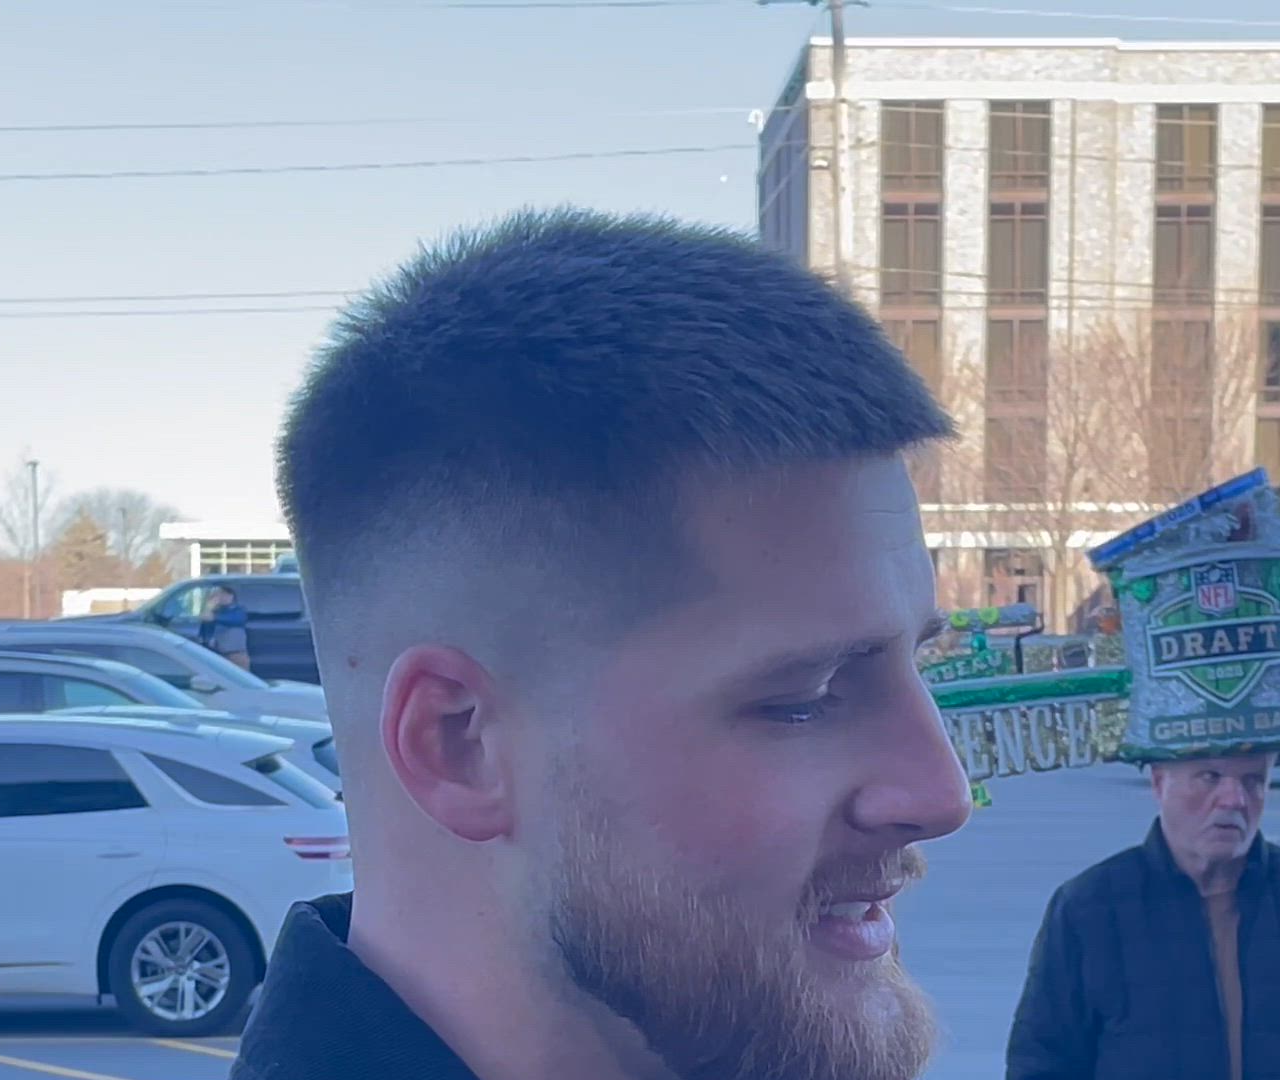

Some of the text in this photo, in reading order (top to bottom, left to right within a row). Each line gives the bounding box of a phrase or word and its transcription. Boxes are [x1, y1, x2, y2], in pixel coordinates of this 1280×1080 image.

[1199, 584, 1235, 609] NFL
[1159, 623, 1278, 661] DRAFT
[1154, 715, 1246, 740] GREEN
